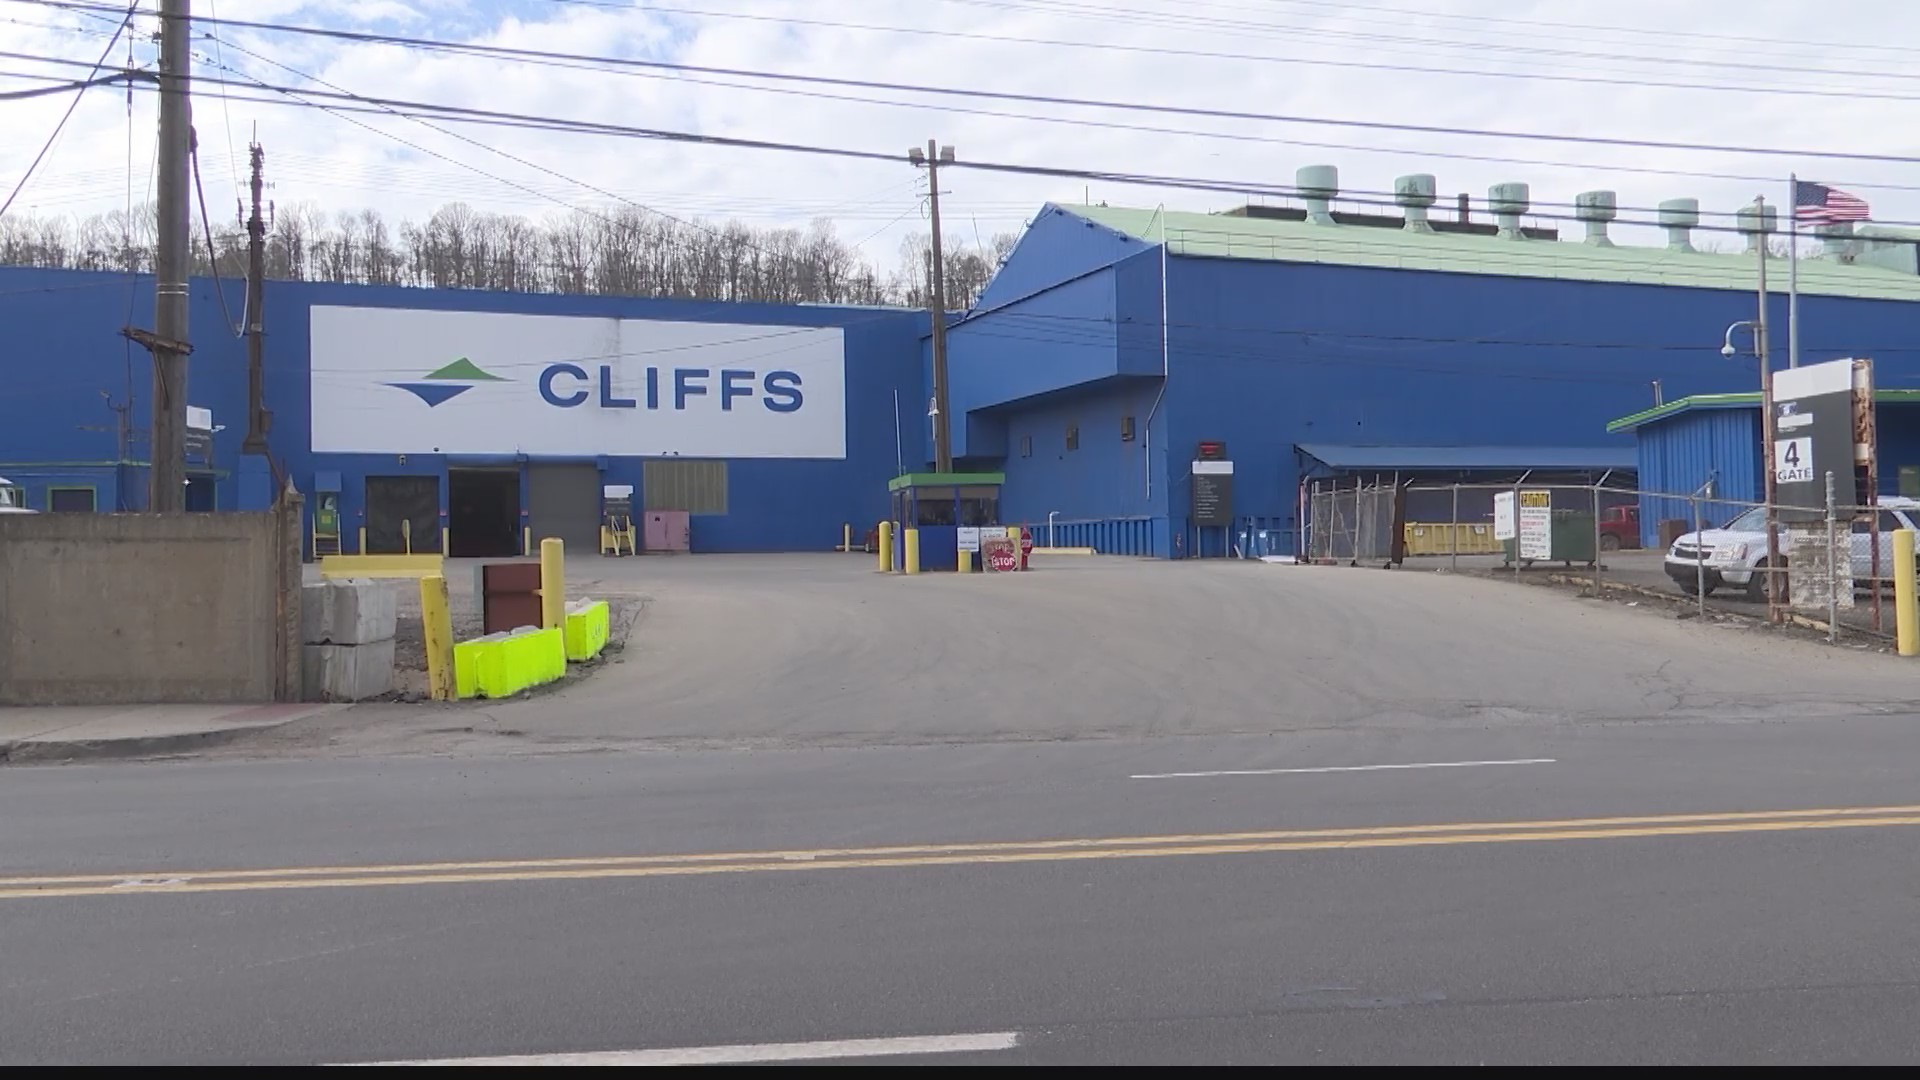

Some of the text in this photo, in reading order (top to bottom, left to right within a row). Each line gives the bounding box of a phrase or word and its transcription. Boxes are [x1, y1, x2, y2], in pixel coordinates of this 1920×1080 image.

[538, 363, 804, 412] CLIFFS
[1784, 441, 1800, 467] 4
[1777, 467, 1812, 480] GATE
[993, 557, 1015, 566] STOP
